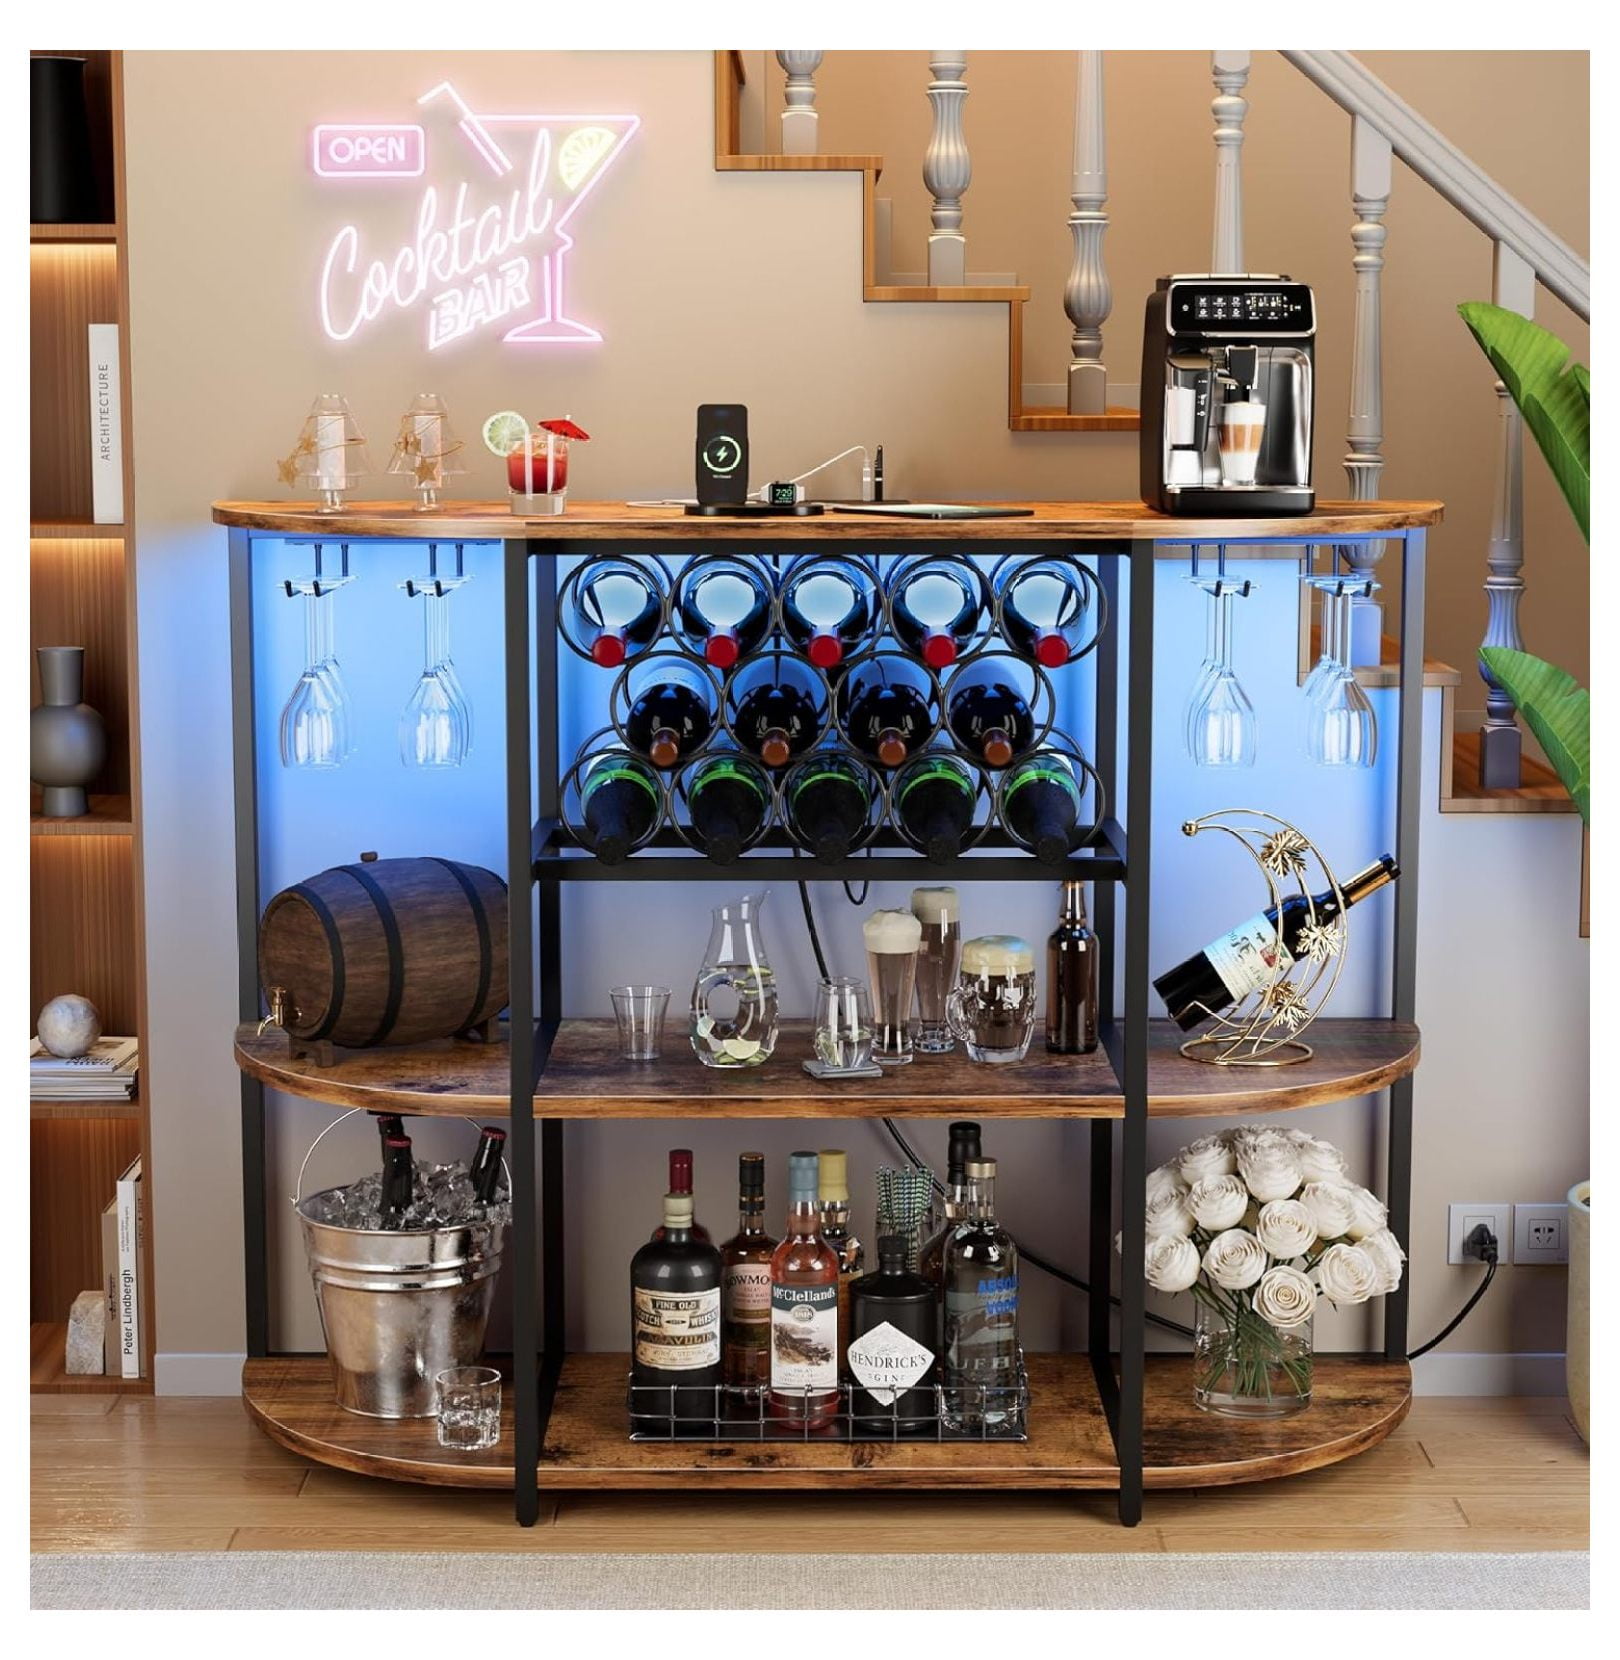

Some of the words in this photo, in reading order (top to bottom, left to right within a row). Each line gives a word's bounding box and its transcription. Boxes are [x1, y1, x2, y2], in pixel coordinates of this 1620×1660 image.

[328, 136, 406, 164] OPEN
[320, 127, 554, 341] Cocktail
[428, 255, 531, 350] BAR
[98, 364, 111, 461] ARCHITECTURE
[121, 1269, 133, 1324] Lindbergh
[655, 1302, 676, 1310] FINE
[679, 1301, 697, 1310] OLD
[123, 1327, 133, 1355] Peter
[850, 1350, 927, 1369] HENDRICK'S
[873, 1374, 899, 1382] GIN
